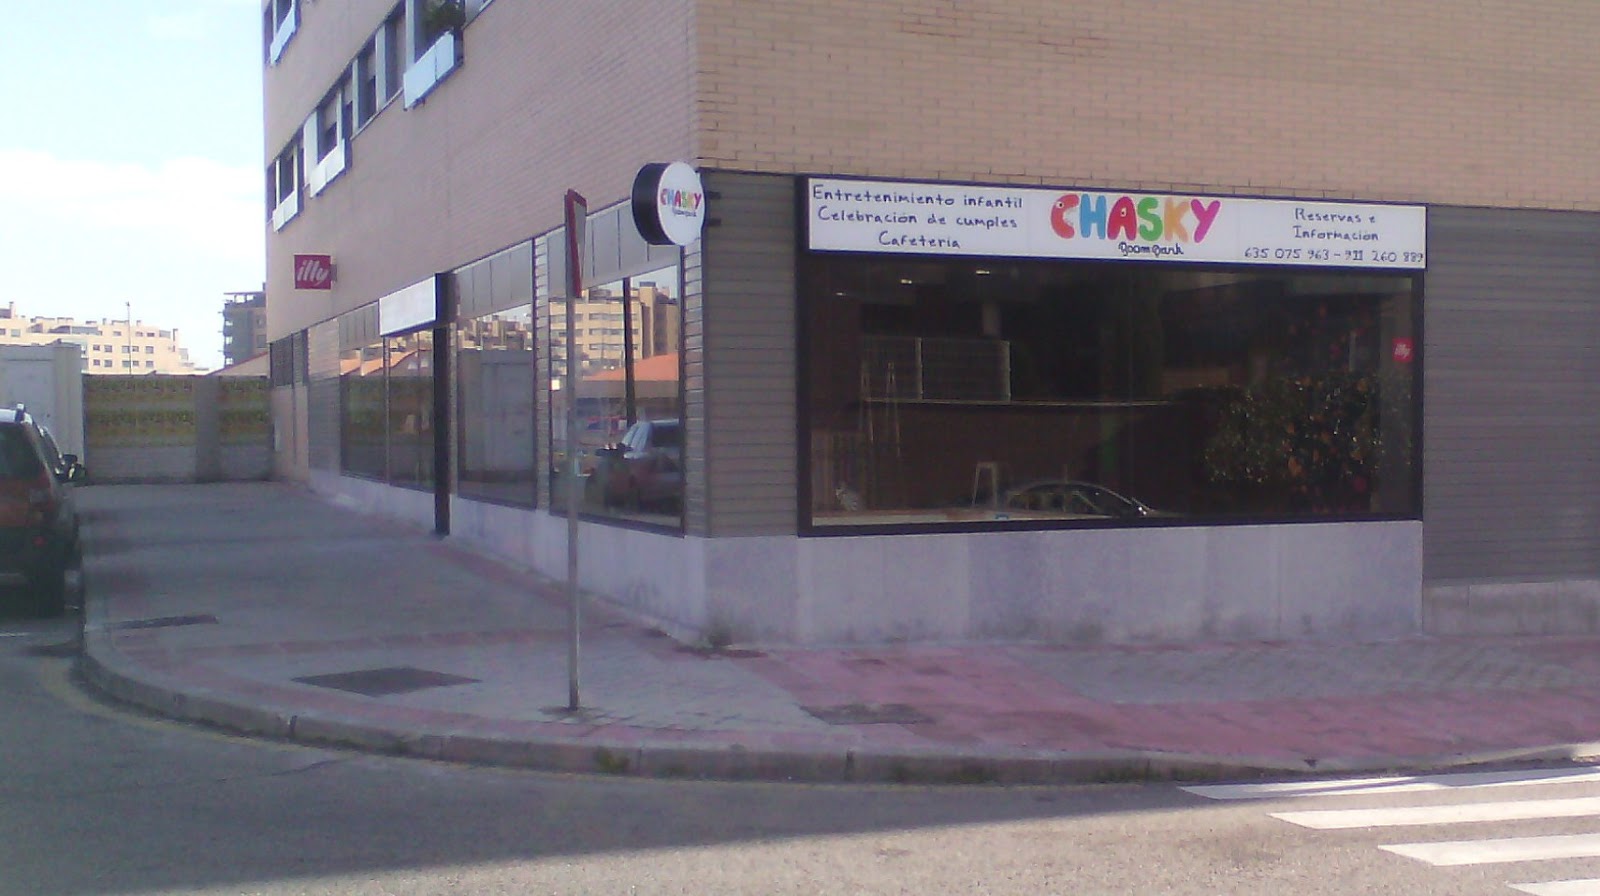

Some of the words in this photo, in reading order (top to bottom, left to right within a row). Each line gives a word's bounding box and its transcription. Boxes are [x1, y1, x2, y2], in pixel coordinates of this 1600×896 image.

[660, 188, 702, 210] CHASKY
[812, 184, 955, 206] Entretenimiento
[963, 194, 1024, 209] infantil
[927, 211, 946, 225] de
[956, 215, 1018, 229] cumples
[1050, 193, 1221, 243] CHASKY
[1294, 207, 1362, 223] Reservas
[1244, 247, 1270, 259] 635
[1274, 248, 1302, 259] 075
[1307, 249, 1330, 260] 963
[1372, 251, 1398, 263] 260
[1403, 251, 1424, 263] 889
[296, 259, 329, 287] illy
